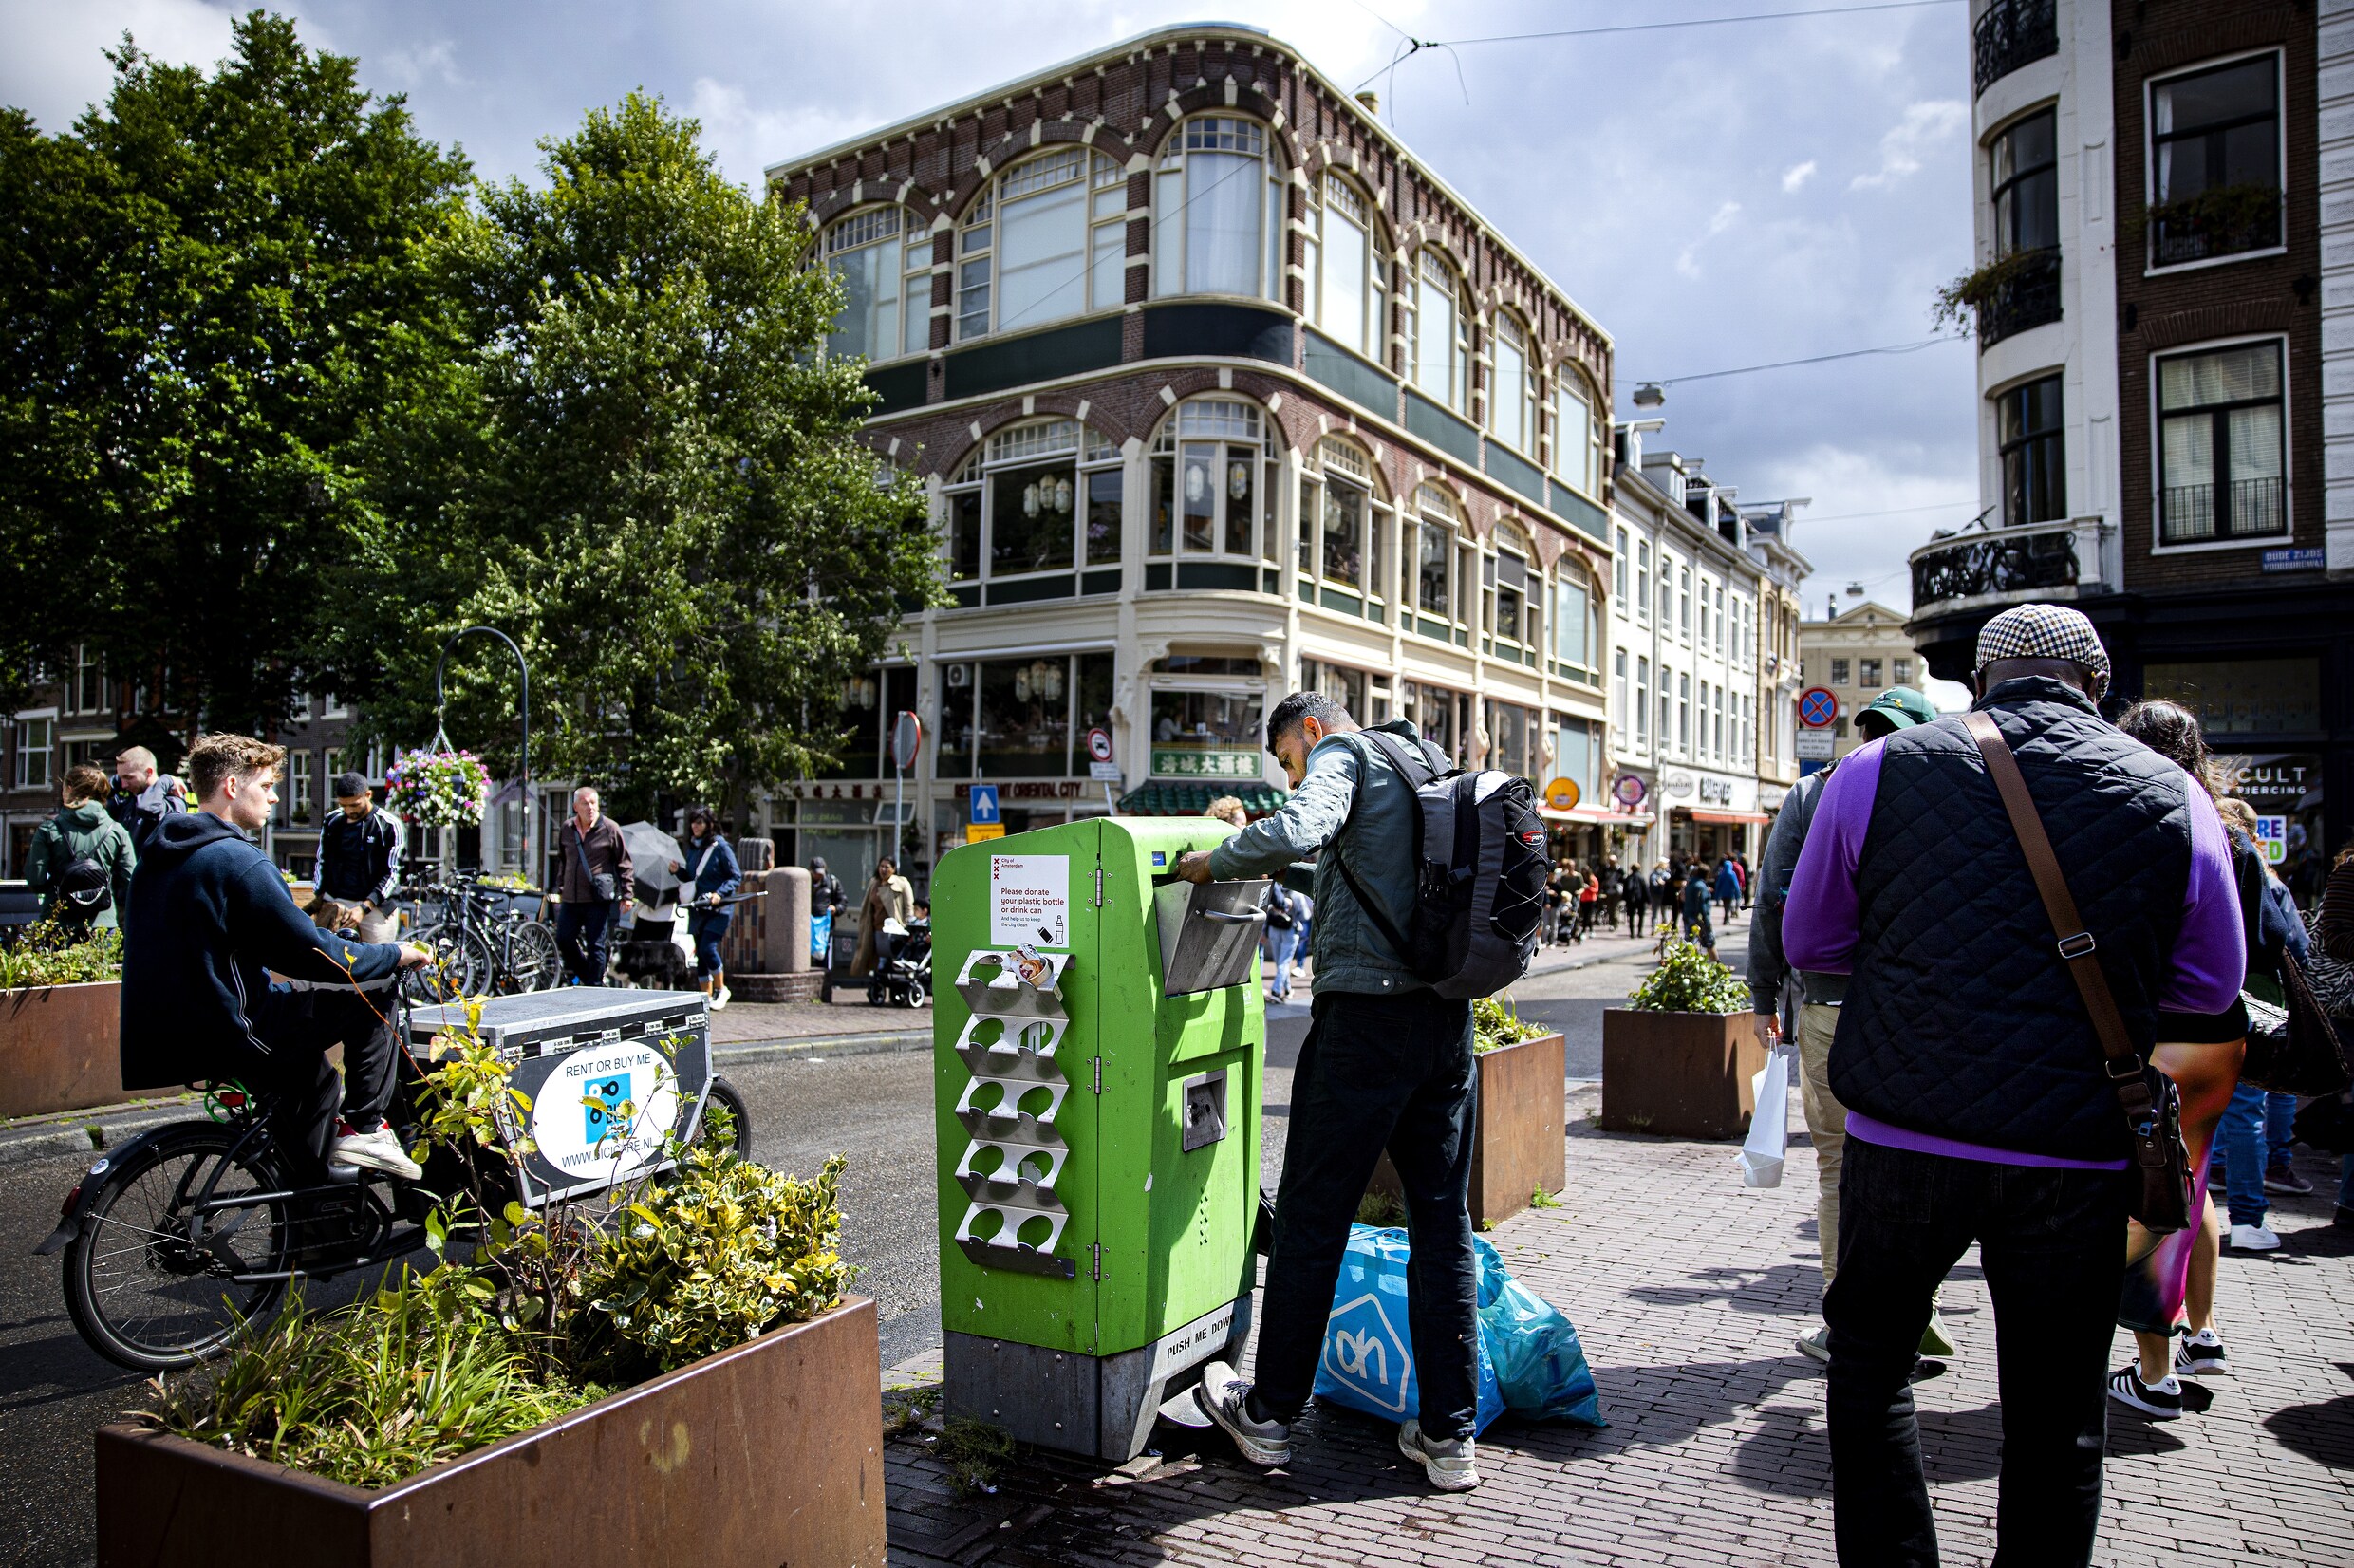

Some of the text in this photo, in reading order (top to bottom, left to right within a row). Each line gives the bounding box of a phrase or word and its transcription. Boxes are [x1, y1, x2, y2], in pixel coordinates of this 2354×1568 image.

[2265, 551, 2290, 561] OUDE
[1059, 781, 1082, 797] CITY
[1018, 898, 1041, 906] plastic
[566, 1053, 651, 1077] RENT OR BUY ME
[1167, 1313, 1235, 1359] PUSH ME DOWN
